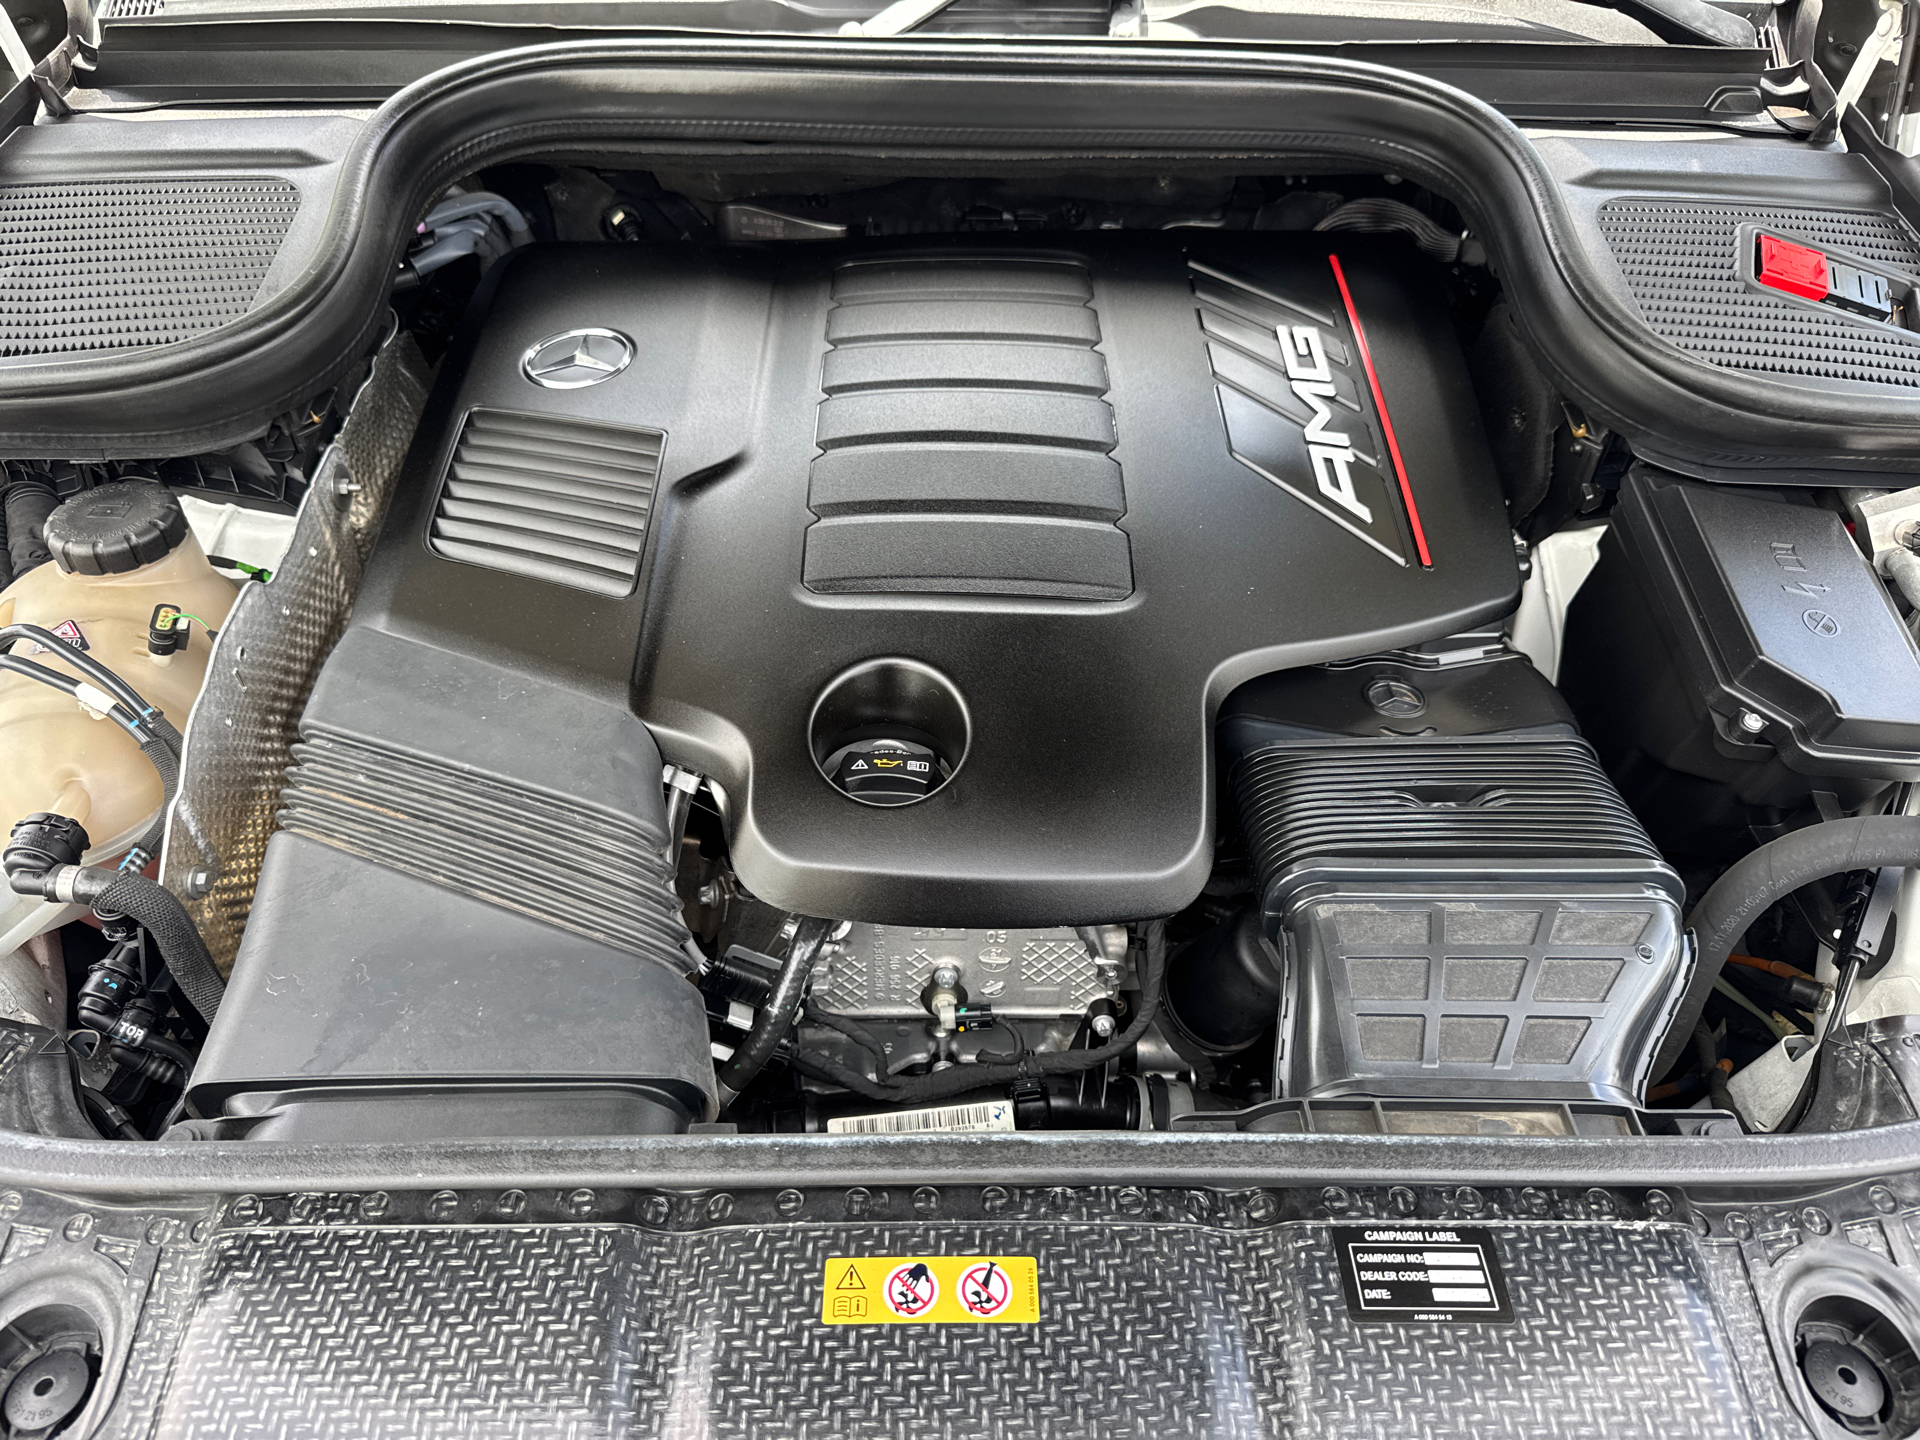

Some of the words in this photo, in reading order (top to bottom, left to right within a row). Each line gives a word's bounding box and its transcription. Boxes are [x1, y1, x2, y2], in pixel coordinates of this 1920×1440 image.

[1275, 325, 1373, 524] AMG
[120, 1021, 145, 1039] TOP
[1364, 1231, 1423, 1241] CAMPAIGN
[1425, 1232, 1461, 1242] LABEL
[1356, 1253, 1405, 1263] CAMPAIGN
[1406, 1253, 1424, 1264] NO:
[1360, 1271, 1397, 1281] DEALER
[1398, 1271, 1428, 1281] CODE:
[1364, 1289, 1391, 1299] DATE:
